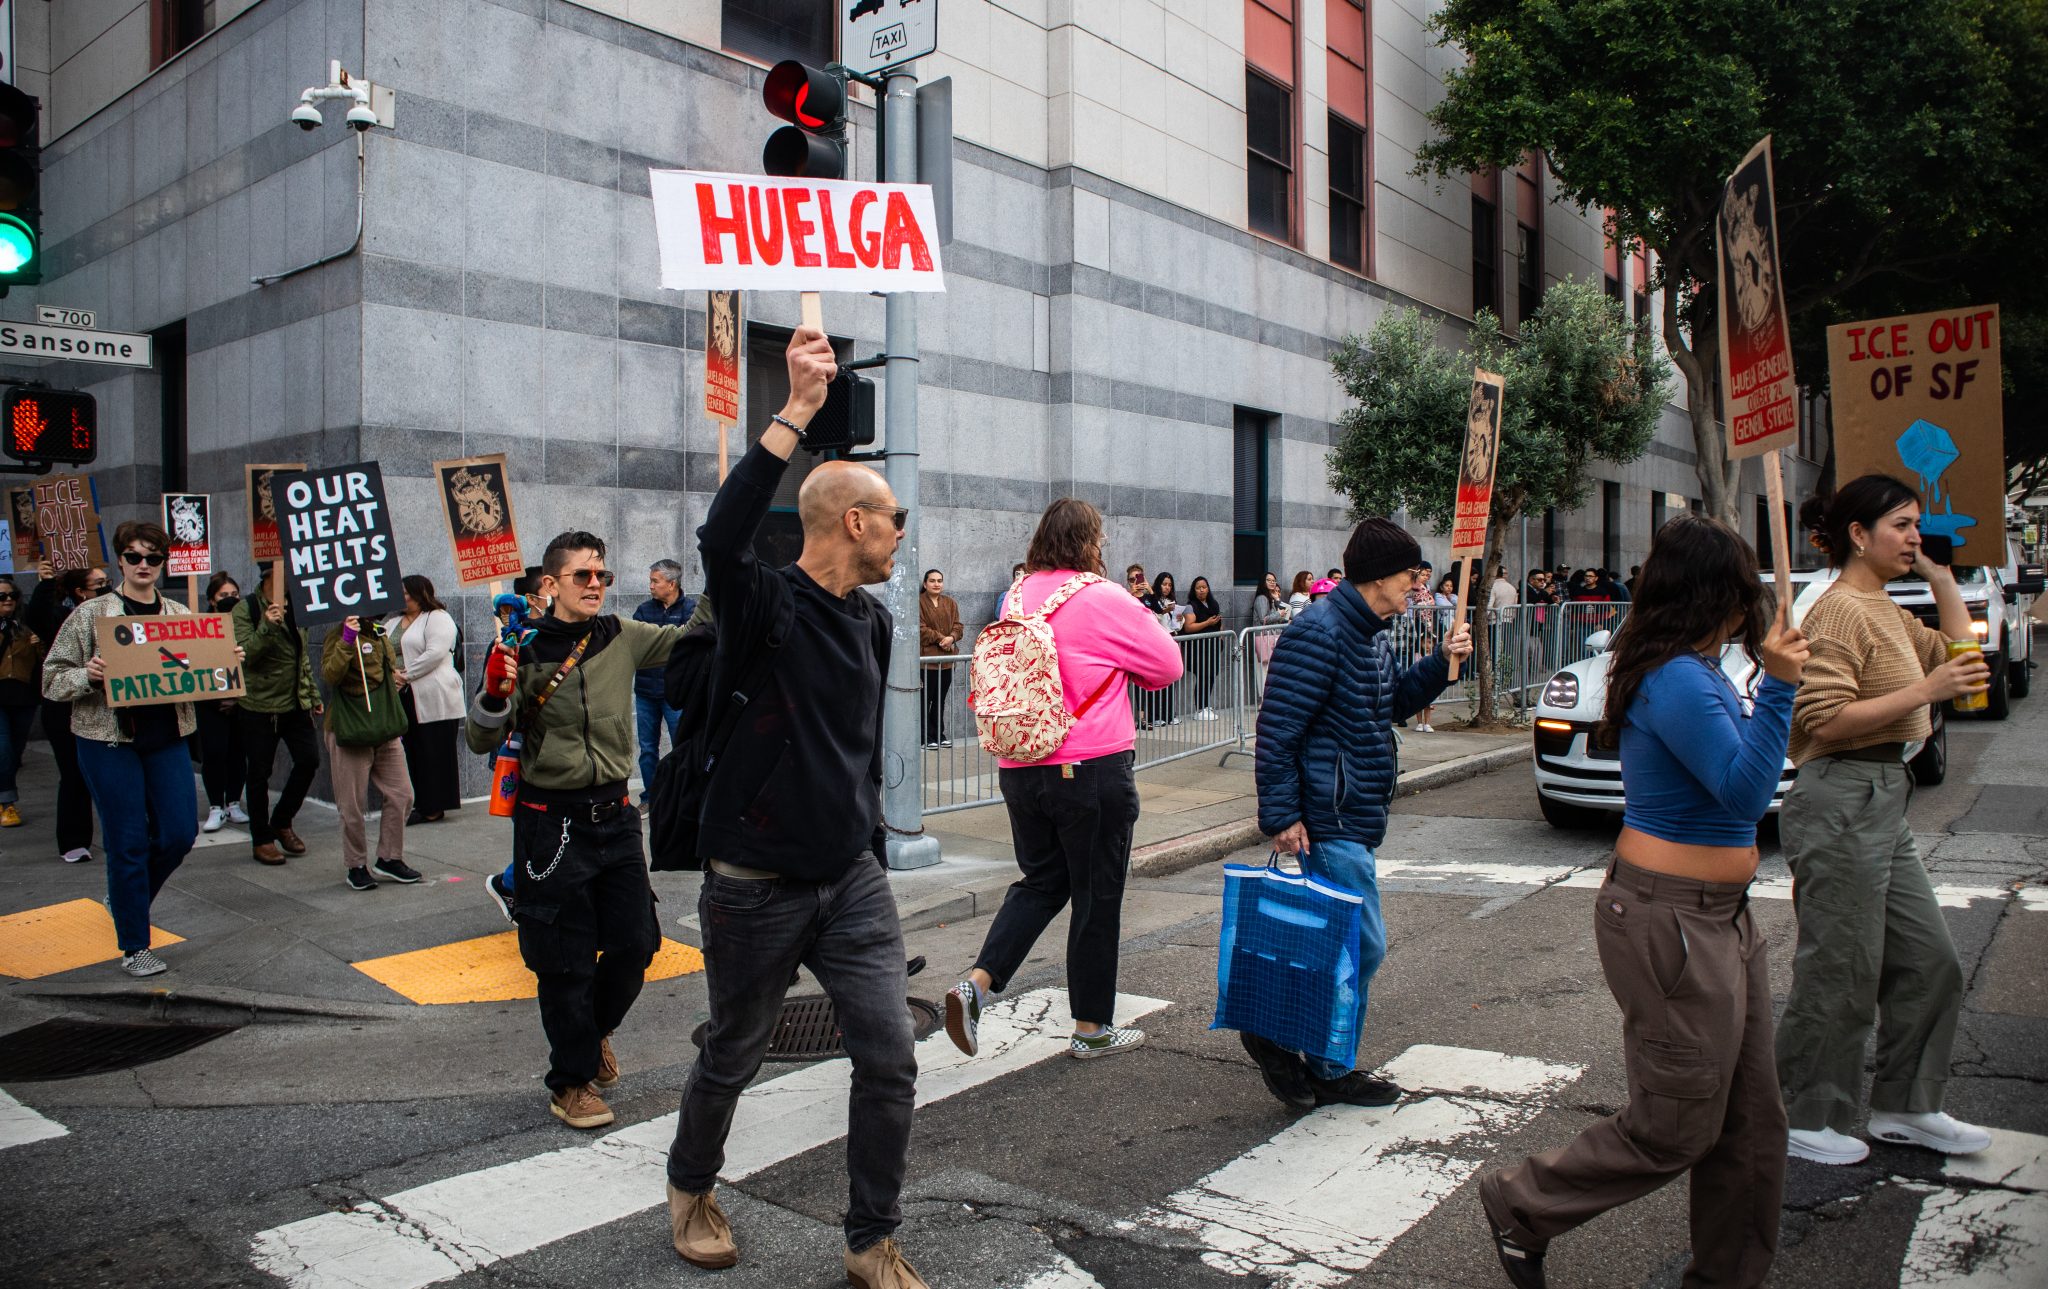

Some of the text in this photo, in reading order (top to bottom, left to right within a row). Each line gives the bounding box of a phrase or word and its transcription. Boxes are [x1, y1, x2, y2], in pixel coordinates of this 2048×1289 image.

[875, 30, 902, 49] TAXI
[695, 183, 934, 271] HUELGA
[60, 311, 91, 326] 700
[1, 327, 132, 358] Sansome
[1847, 310, 1994, 361] I.C.E. OUT
[1870, 359, 1979, 401] OF SF
[37, 479, 83, 506] ICE
[286, 472, 374, 508] OUR
[41, 502, 88, 533] OUT
[287, 501, 378, 542] HEAT
[45, 529, 87, 552] THE
[289, 534, 387, 576] MELTS
[458, 541, 517, 560] HUELGA GENERAL
[53, 549, 89, 571] BAY
[463, 560, 521, 580] GENERAL STRIKE
[300, 568, 388, 612] ICE
[114, 616, 225, 646] OBEDIENCE
[110, 666, 242, 702] PATRIOTISM
